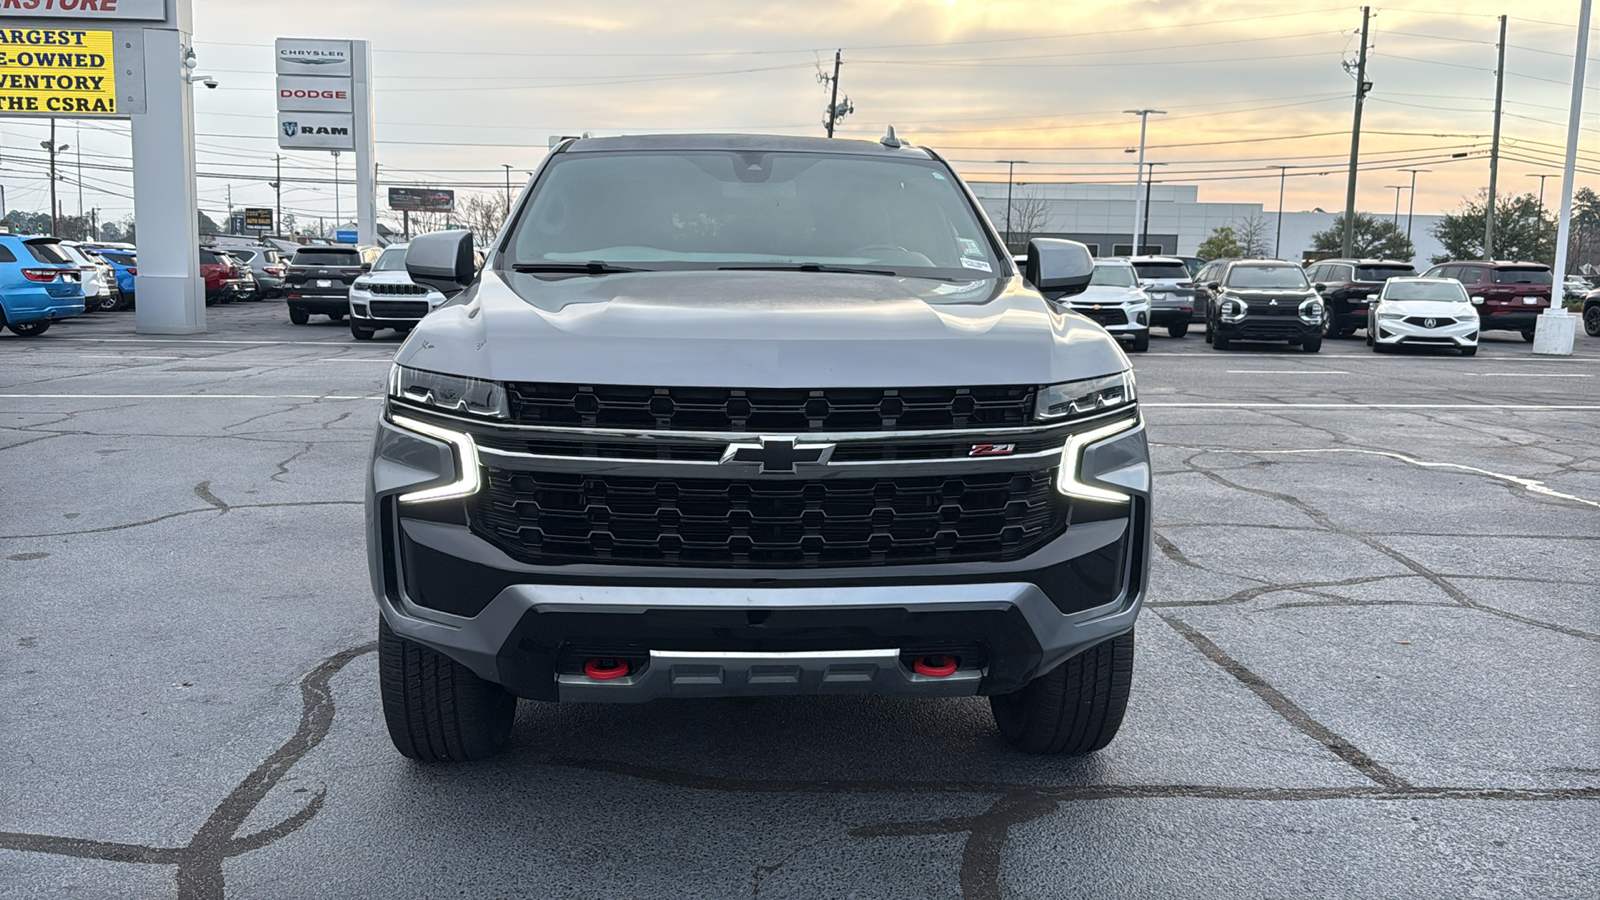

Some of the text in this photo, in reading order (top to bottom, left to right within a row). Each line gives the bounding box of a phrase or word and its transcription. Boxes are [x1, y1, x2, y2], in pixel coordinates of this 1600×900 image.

[0, 30, 86, 45] ARGEST
[280, 49, 344, 57] CHRYSLER
[0, 52, 105, 68] E-OWNED
[280, 89, 347, 100] DODGE
[46, 97, 114, 112] CSRA!
[301, 126, 348, 135] RAM
